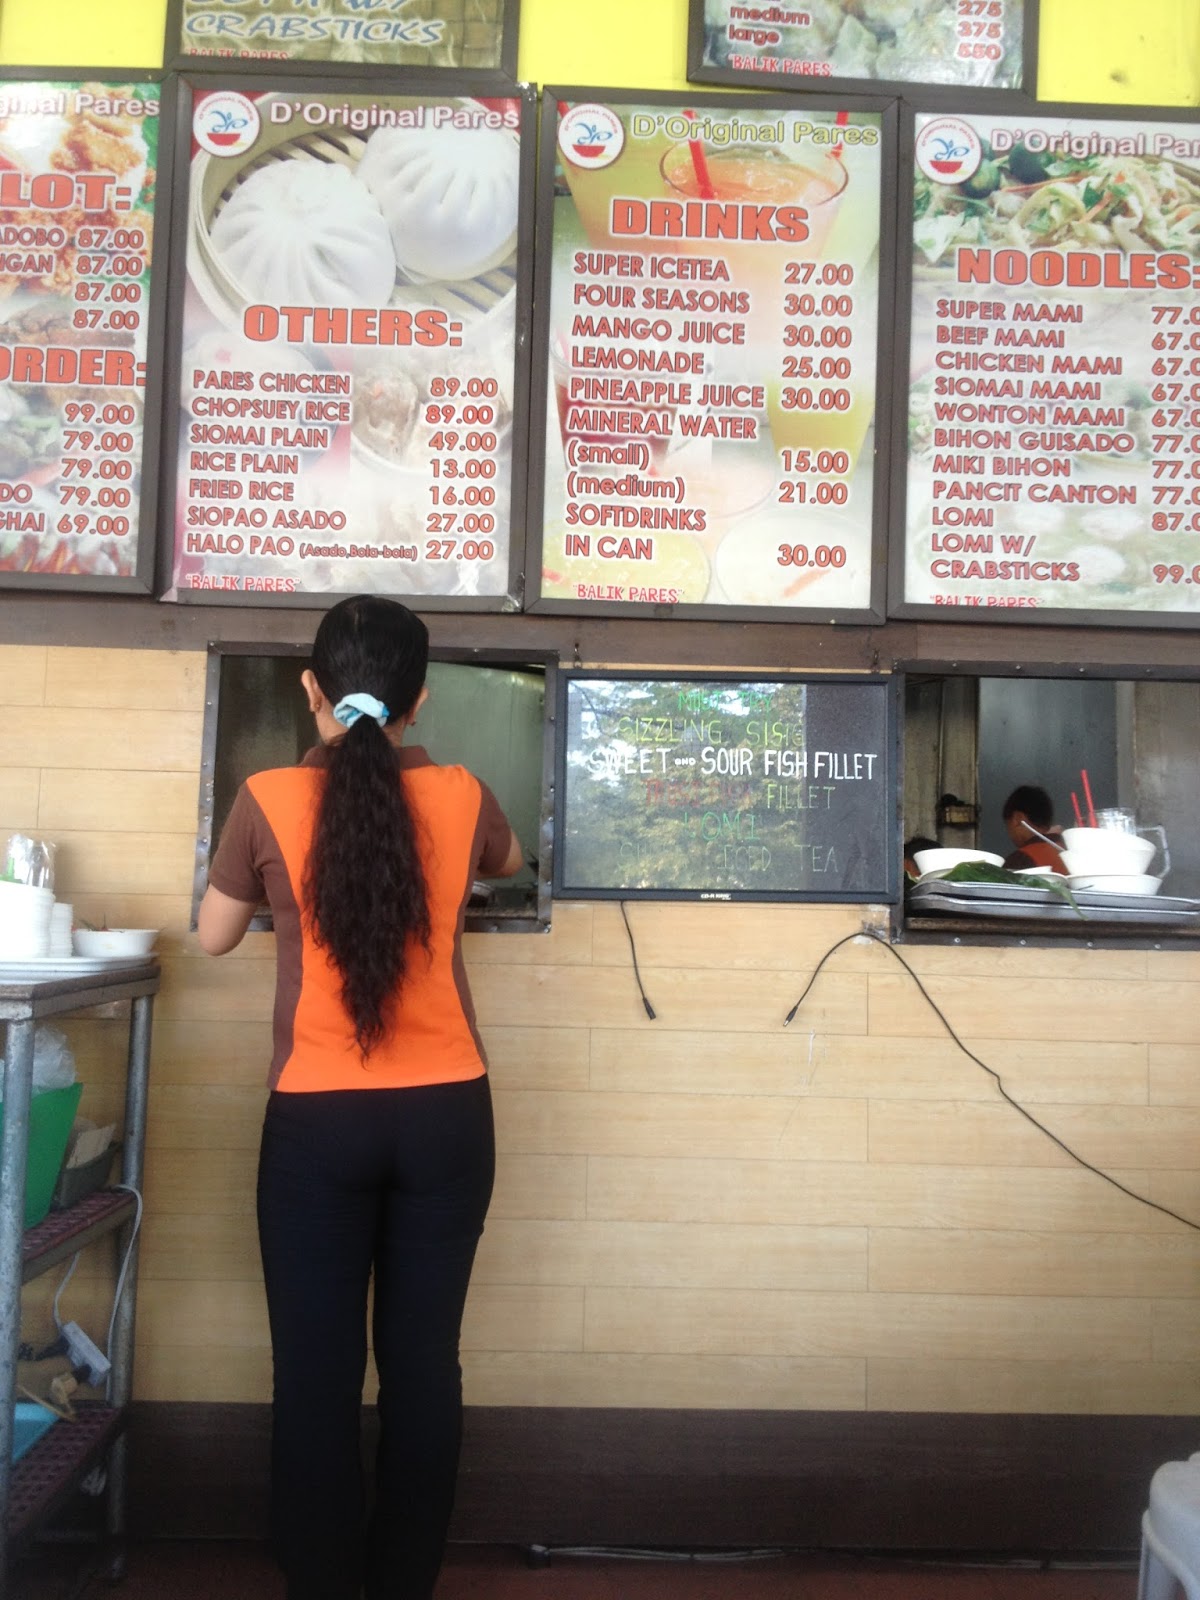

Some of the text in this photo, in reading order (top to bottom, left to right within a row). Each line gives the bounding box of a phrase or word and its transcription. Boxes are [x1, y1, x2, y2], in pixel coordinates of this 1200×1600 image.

[730, 6, 810, 25] medium
[958, 0, 1002, 17] 275
[186, 14, 446, 44] CRABSTICKS
[729, 24, 780, 46] large
[957, 21, 1001, 38] 375
[957, 43, 1001, 60] 550
[75, 92, 160, 116] Pares
[270, 102, 424, 131] D'Original
[433, 105, 520, 130] Pares
[633, 114, 784, 145] D'Original
[794, 121, 878, 146] Pares
[991, 129, 1144, 158] D'Original
[1, 173, 131, 210] LOT:
[612, 199, 809, 242] DRINKS
[0, 227, 144, 248] DOBO 87.00
[76, 255, 143, 276] 87.00
[574, 252, 853, 285] SUPER ICETEA 27.00
[957, 248, 1200, 289] NOODLES:
[75, 282, 141, 302] 87.00
[574, 284, 852, 317] FOUR SEASONS 30.00
[73, 309, 140, 330] 87.00
[936, 299, 1005, 320] SUPER
[1013, 303, 1083, 323] MAMI
[243, 305, 463, 347] OTHERS:
[572, 315, 851, 348] MANGO JUICE 30.00
[937, 325, 988, 344] BEEF
[994, 328, 1065, 348] MAMI
[571, 346, 851, 379] LEMONADE 25.00
[935, 352, 1044, 373] CHICKEN
[1051, 356, 1122, 375] MAMI
[193, 370, 498, 398] PARES CHICKEN 89.00
[571, 378, 850, 411] PINEAPPLE JUICE 30.00
[934, 377, 1023, 398] SIOMAI
[1029, 381, 1101, 400] MAMI
[65, 403, 135, 425] 99.00
[192, 397, 493, 424] CHOPSUEY RICE 89.00
[934, 402, 1045, 424] WONTON
[1053, 407, 1124, 426] MAMI
[569, 409, 756, 439] MINERAL WATER
[63, 431, 134, 452] 79.00
[191, 424, 497, 451] SIOMAI PLAIN 49.00
[934, 428, 1011, 449] BIHON
[1019, 432, 1134, 452] GUISADO
[62, 458, 132, 480] 79.00
[191, 451, 496, 479] RICE PLAIN 13.00
[568, 440, 849, 473] (small) 15.00
[932, 455, 984, 474] MIKI
[993, 457, 1071, 477] BIHON
[60, 486, 131, 508] 79.00
[189, 479, 495, 506] FRIED RICE 16.00
[567, 471, 848, 504] (medium) 21.00
[933, 480, 1021, 501] PANCIT
[1028, 483, 1136, 504] CANTON
[57, 514, 130, 536] 69.00
[187, 506, 495, 533] SIOPAO ASADO 27.00
[565, 503, 706, 531] SOFTDRINKS
[932, 506, 993, 527] LOMI
[187, 534, 244, 555] HALO
[250, 536, 295, 556] PAO
[425, 540, 494, 560] 27.00
[565, 535, 846, 567] IN CAN 30.00
[931, 533, 993, 553] LOMI
[930, 559, 1080, 581] CRABSTICKS
[618, 716, 722, 744] SIZZLING
[588, 748, 672, 775] SWEET
[701, 747, 753, 776] SOUR
[764, 750, 808, 778] FISH
[814, 751, 878, 780] FILLET
[767, 784, 836, 809] FILLET
[794, 844, 839, 873] TEA
